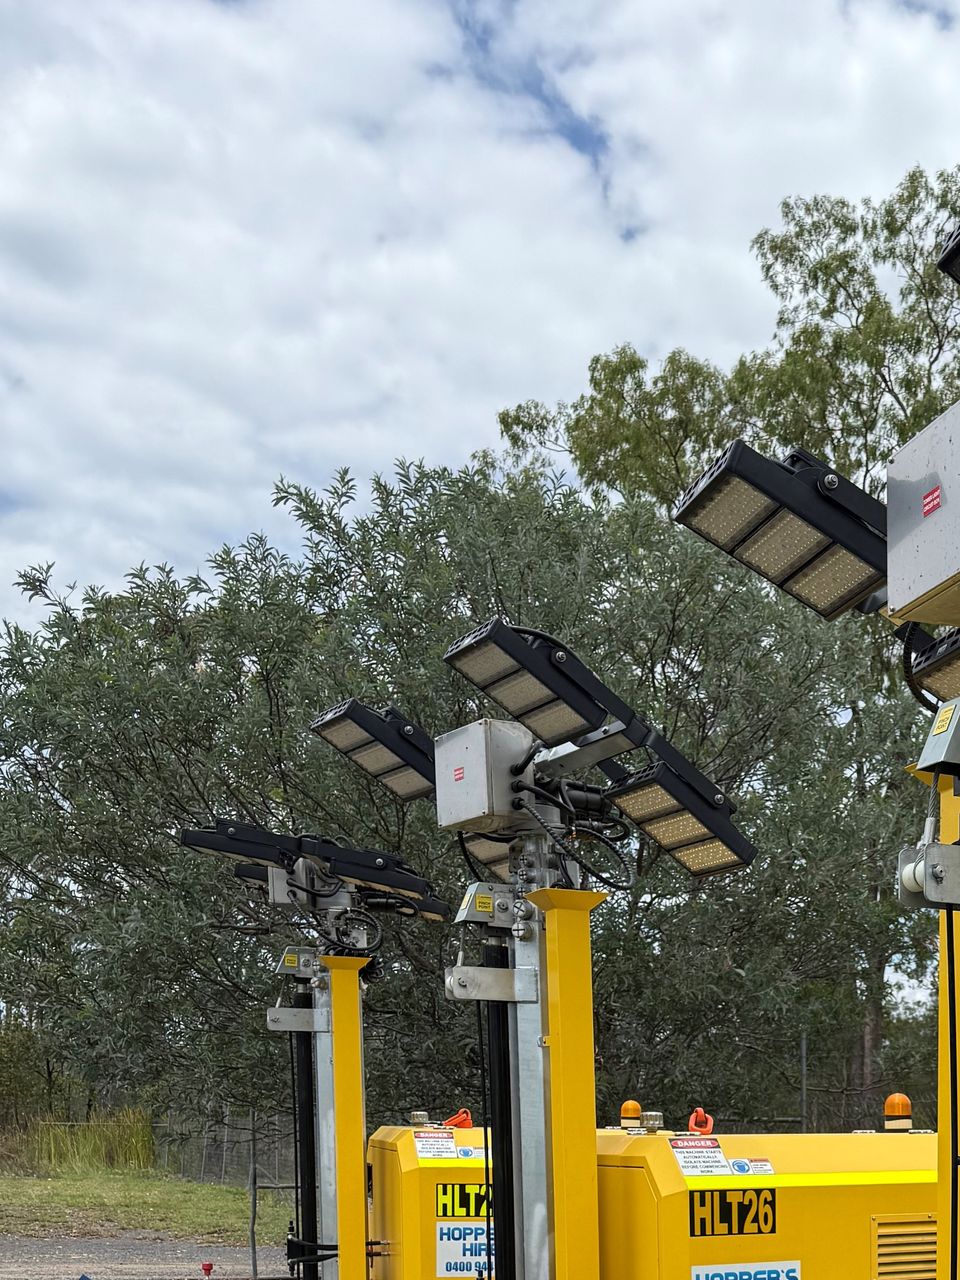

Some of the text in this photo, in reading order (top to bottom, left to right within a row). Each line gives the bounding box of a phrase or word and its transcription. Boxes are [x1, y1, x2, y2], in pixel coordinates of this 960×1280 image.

[437, 1184, 493, 1217] HLT2
[693, 1189, 774, 1235] HLT26
[440, 1227, 494, 1241] HOPP
[445, 1261, 472, 1272] 0400
